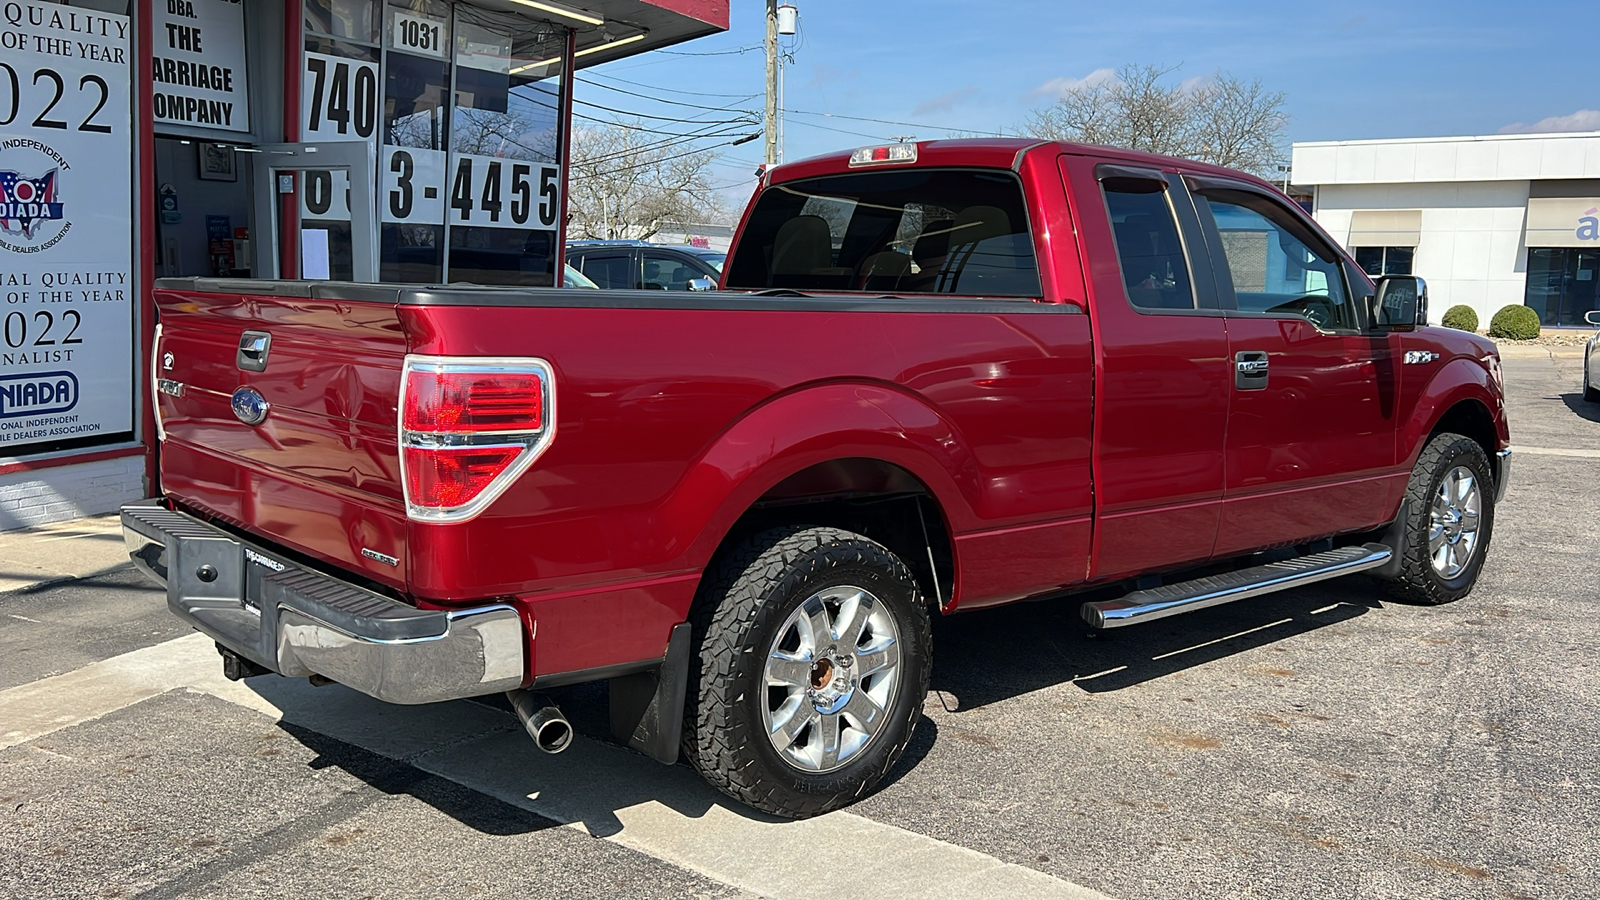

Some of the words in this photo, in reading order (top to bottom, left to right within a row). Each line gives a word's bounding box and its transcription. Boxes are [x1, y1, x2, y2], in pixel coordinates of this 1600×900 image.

[4, 2, 128, 39] QUALITY
[167, 0, 198, 19] DBA.
[1, 31, 28, 50] OF
[33, 35, 73, 57] THE
[77, 42, 126, 64] YEAR
[165, 22, 203, 53] THE
[400, 20, 439, 51] 1031
[152, 56, 233, 93] ARRIAGE
[153, 92, 233, 126] OMPANY
[307, 57, 376, 138] 740
[2, 138, 71, 172] INDEPENDENT
[12, 245, 40, 254] DEALERS
[41, 221, 72, 251] ASSOCIATION
[0, 273, 31, 286] AL
[42, 272, 127, 288] QUALITY
[7, 291, 30, 304] OF
[39, 290, 73, 303] THE
[82, 290, 125, 302] YEAR
[4, 309, 83, 348] 022
[3, 350, 74, 366] NALIST
[0, 380, 69, 408] NIADA
[1, 421, 24, 431] ONAL
[26, 415, 79, 428] INDEPENDENT
[13, 429, 48, 440] DEALERS
[49, 423, 101, 436] ASSOCIATION
